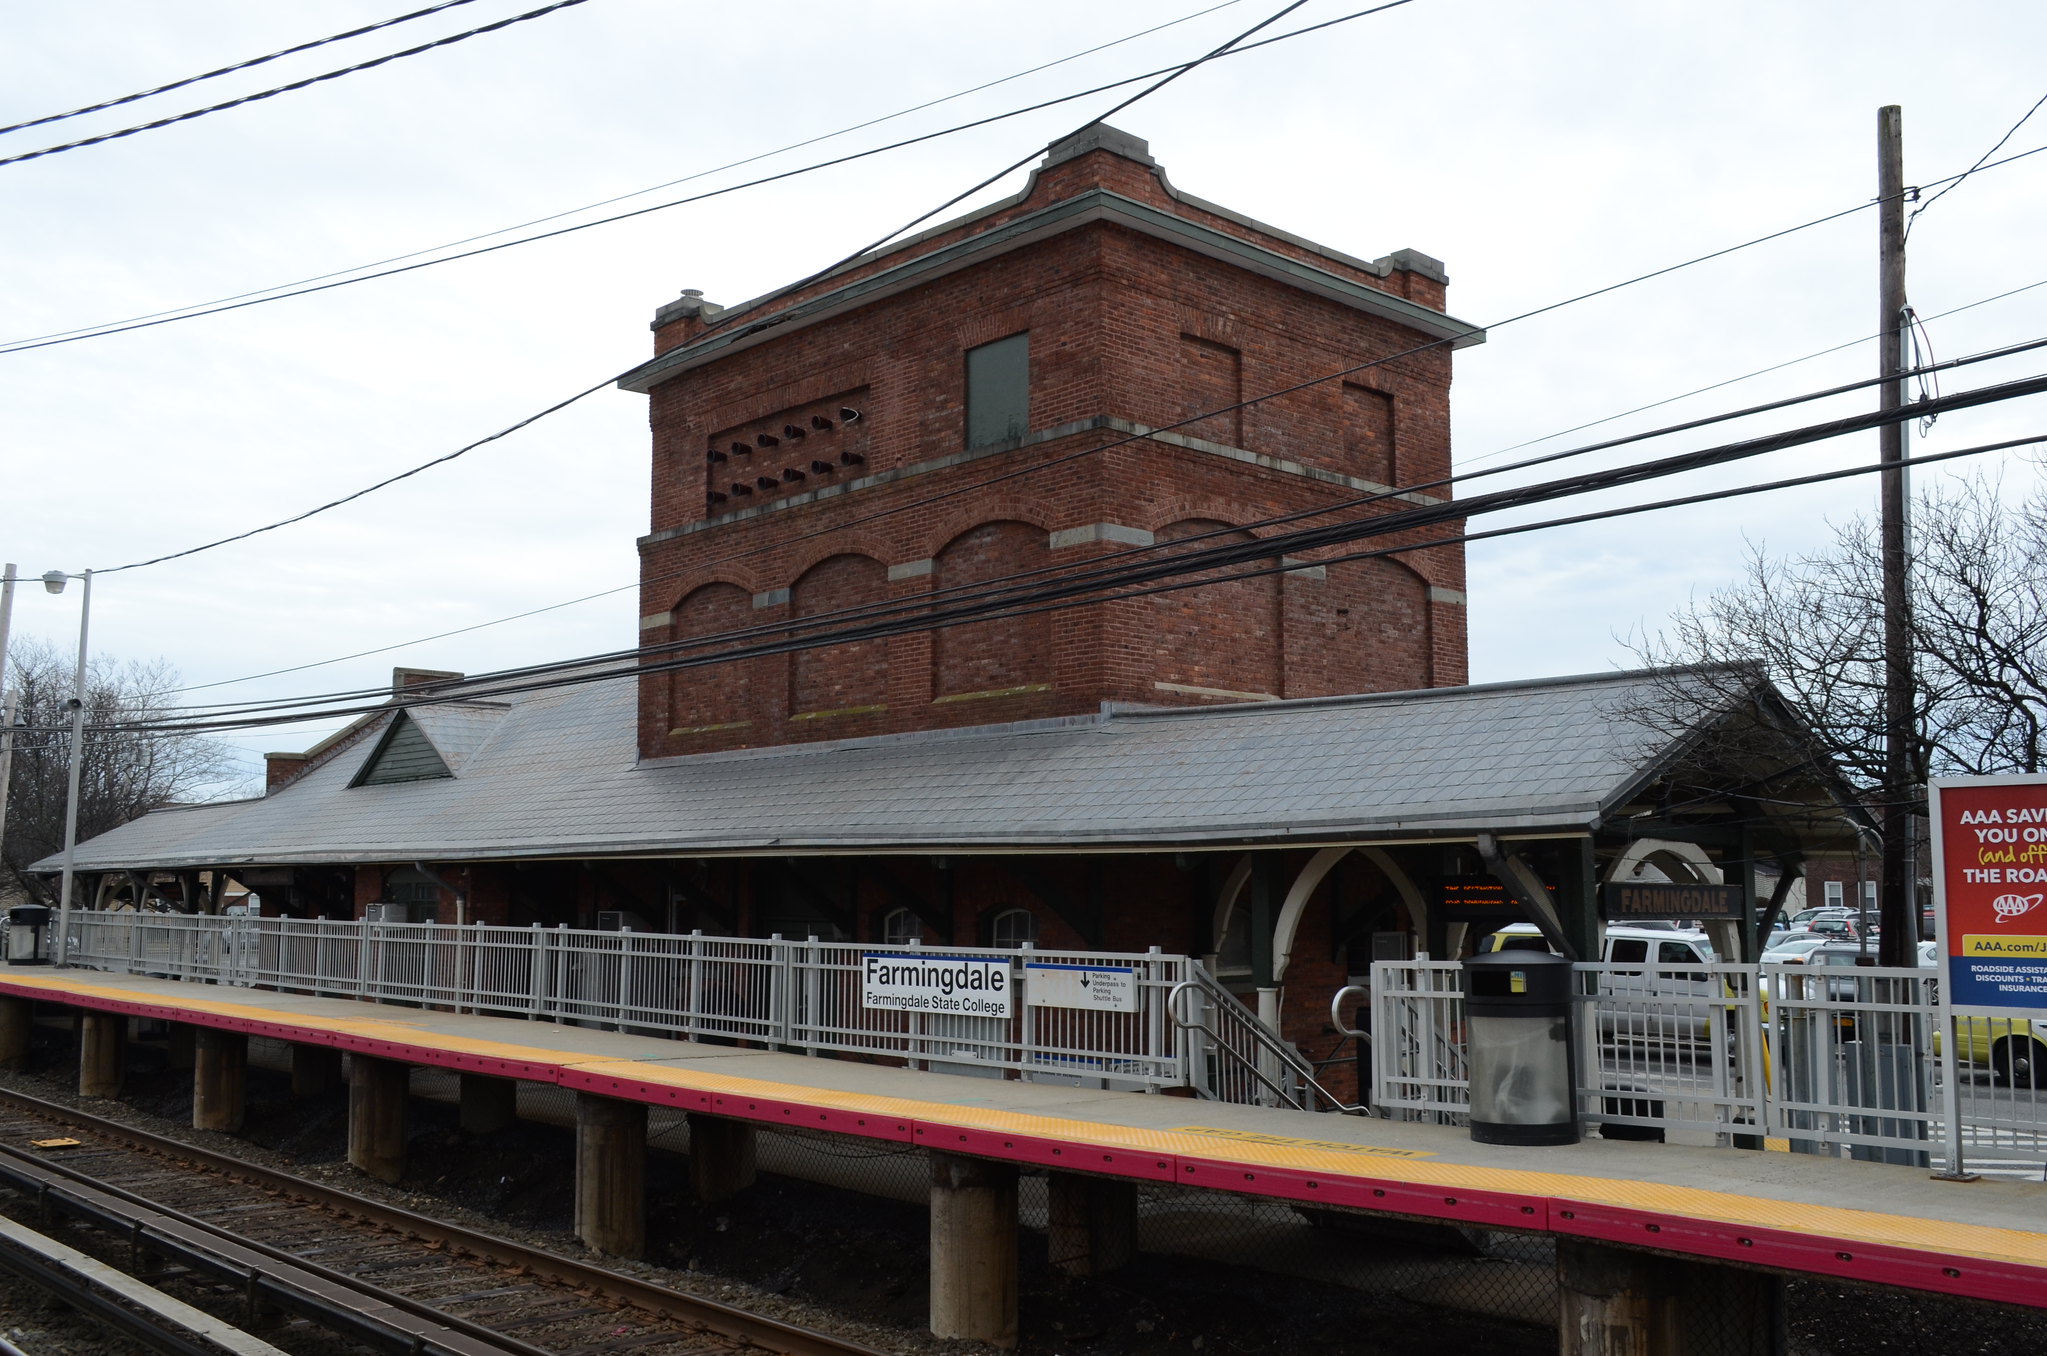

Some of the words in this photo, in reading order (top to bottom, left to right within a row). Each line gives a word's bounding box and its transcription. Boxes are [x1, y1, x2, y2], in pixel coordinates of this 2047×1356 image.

[1960, 809, 2003, 825] AAA
[2006, 808, 2047, 824] SAV
[1974, 828, 2018, 843] YOU
[1978, 845, 2017, 866] (and
[1962, 868, 2002, 884] THE
[1621, 888, 1729, 913] FARMINGDALE
[1974, 941, 2047, 953] AAA.com/J
[1970, 965, 2014, 973] ROADSIDE
[866, 958, 1005, 996] Farmingdale
[1092, 980, 1119, 988] Underpass
[1975, 974, 2024, 983] DISCOUNTS
[1092, 987, 1112, 995] Parking
[1093, 994, 1111, 1002] Shuttle
[866, 991, 930, 1010] Farmingdale
[931, 995, 961, 1011] State
[962, 997, 1005, 1016] College
